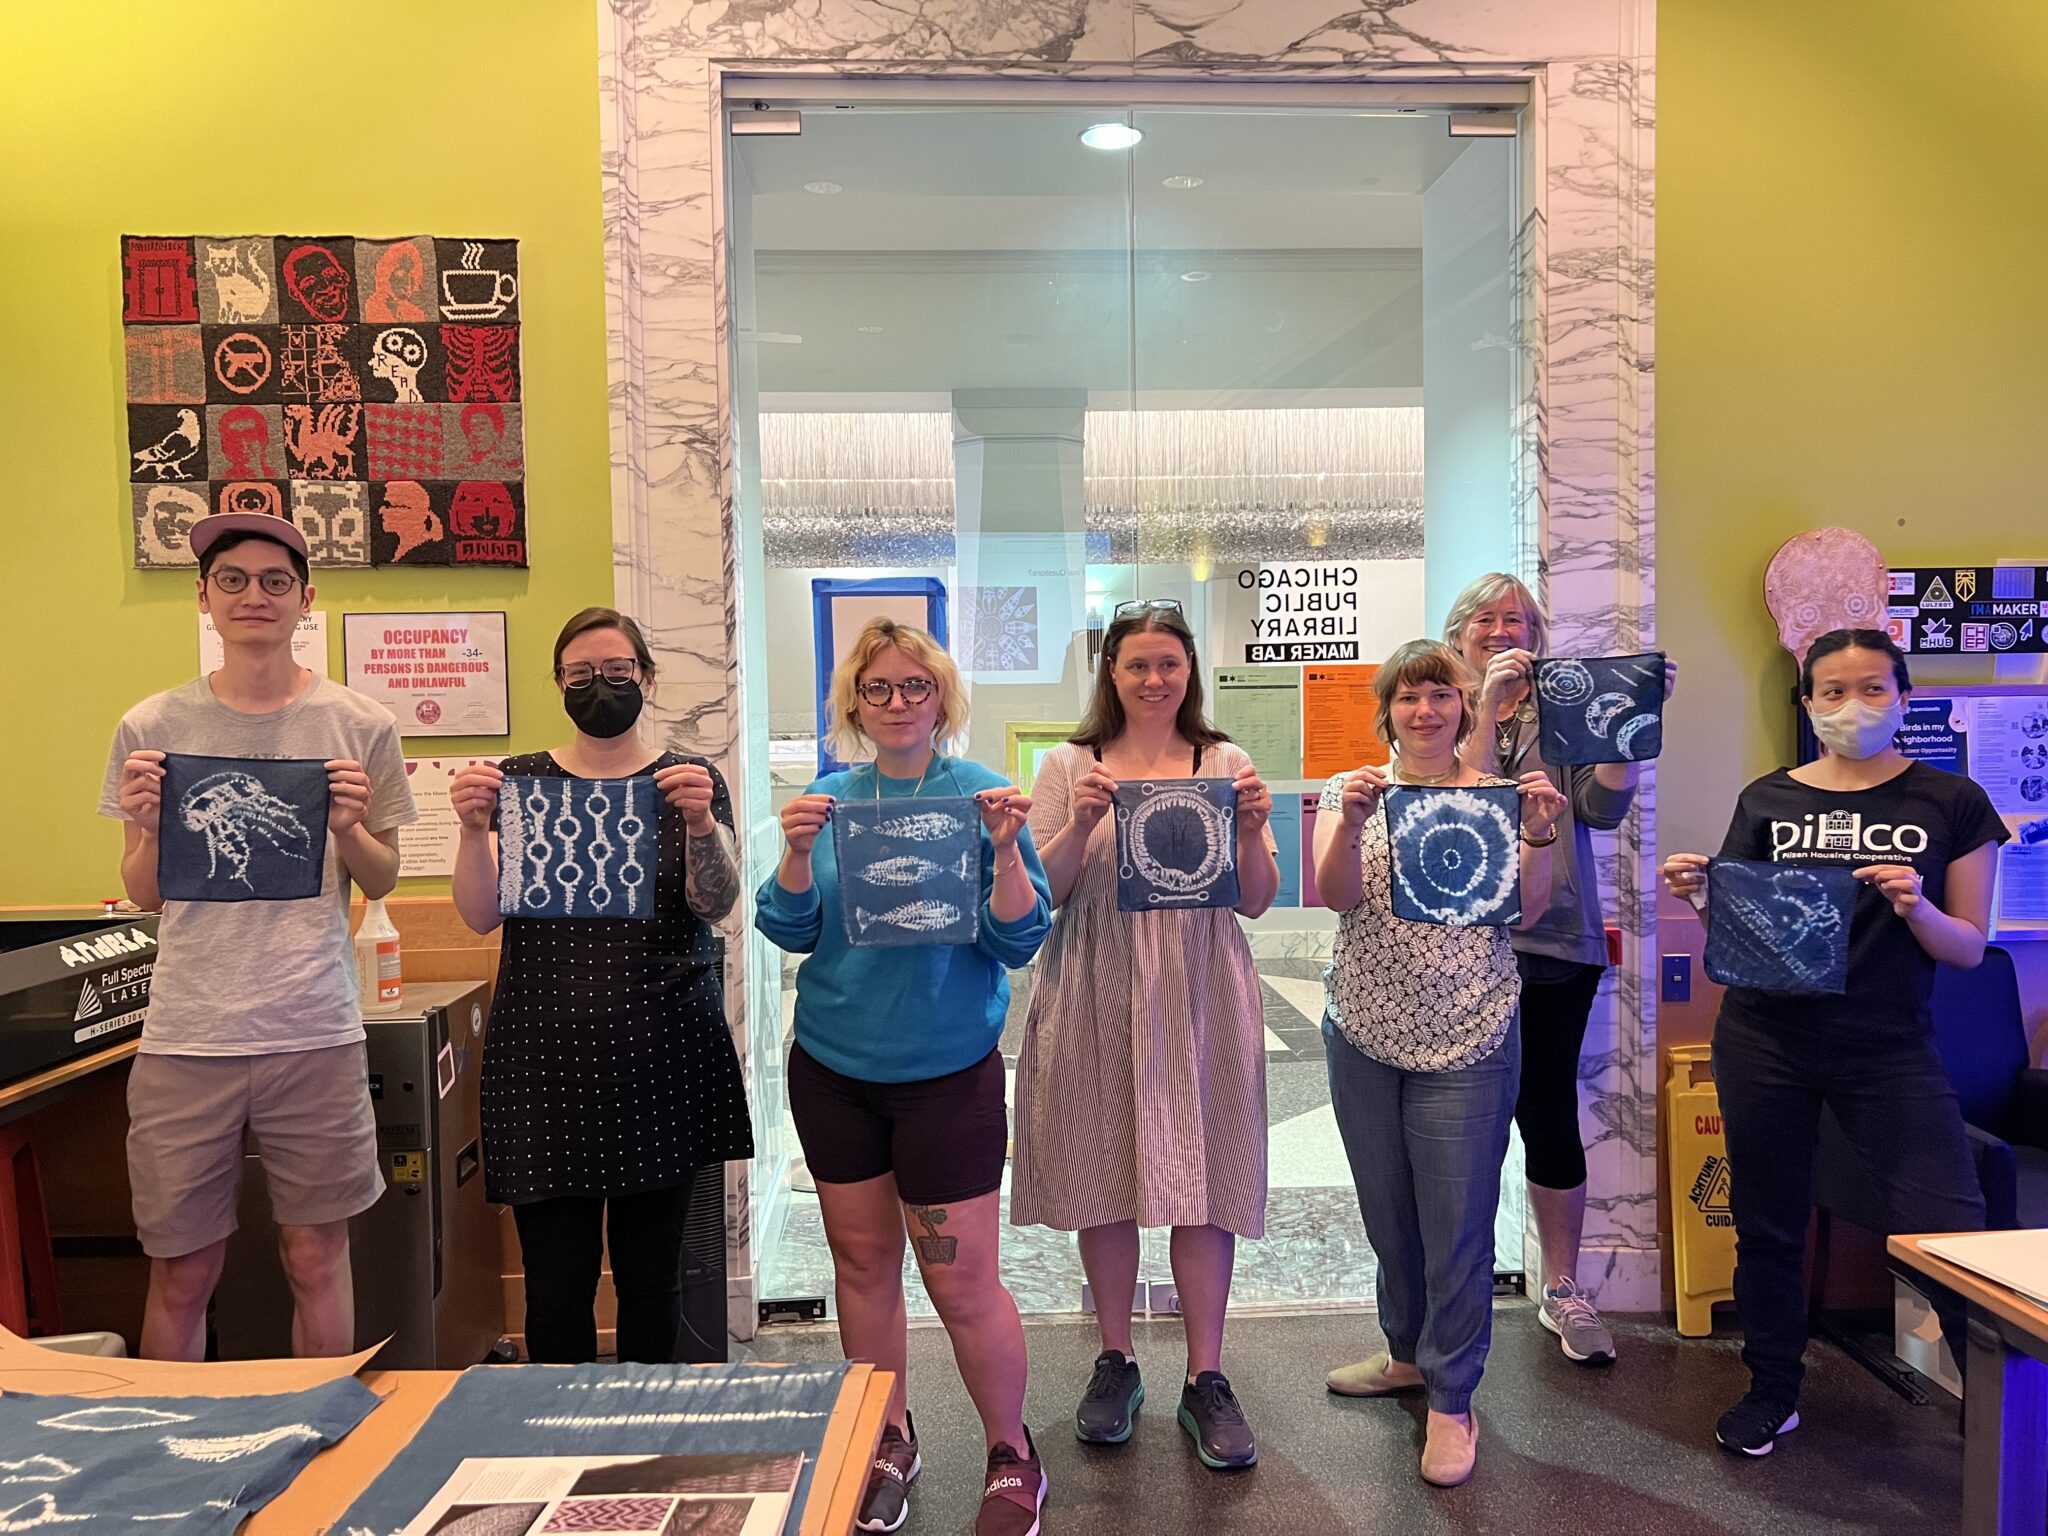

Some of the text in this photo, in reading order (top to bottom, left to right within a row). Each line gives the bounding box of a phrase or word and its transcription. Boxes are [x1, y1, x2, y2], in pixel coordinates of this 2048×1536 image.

[462, 543, 518, 556] ANNA
[1992, 603, 2038, 615] MAKER
[383, 629, 468, 645] OCCUPANCY
[371, 648, 483, 659] BY MORE THAN -34-
[364, 662, 489, 674] PERSONS IS DANGEROUS
[388, 677, 466, 688] AND UNLAWFUL
[1922, 723, 1931, 731] in
[1932, 724, 1945, 733] my
[1810, 852, 1851, 860] Housing
[1852, 853, 1912, 862] Cooperative
[101, 963, 155, 987] Full Spectru
[111, 982, 147, 1004] LASE
[90, 1017, 126, 1036] H-SERIES
[128, 1014, 137, 1023] 20
[1688, 1155, 1719, 1205] ACHTUNG
[873, 1458, 904, 1481] didas
[984, 1476, 1022, 1497] adidas
